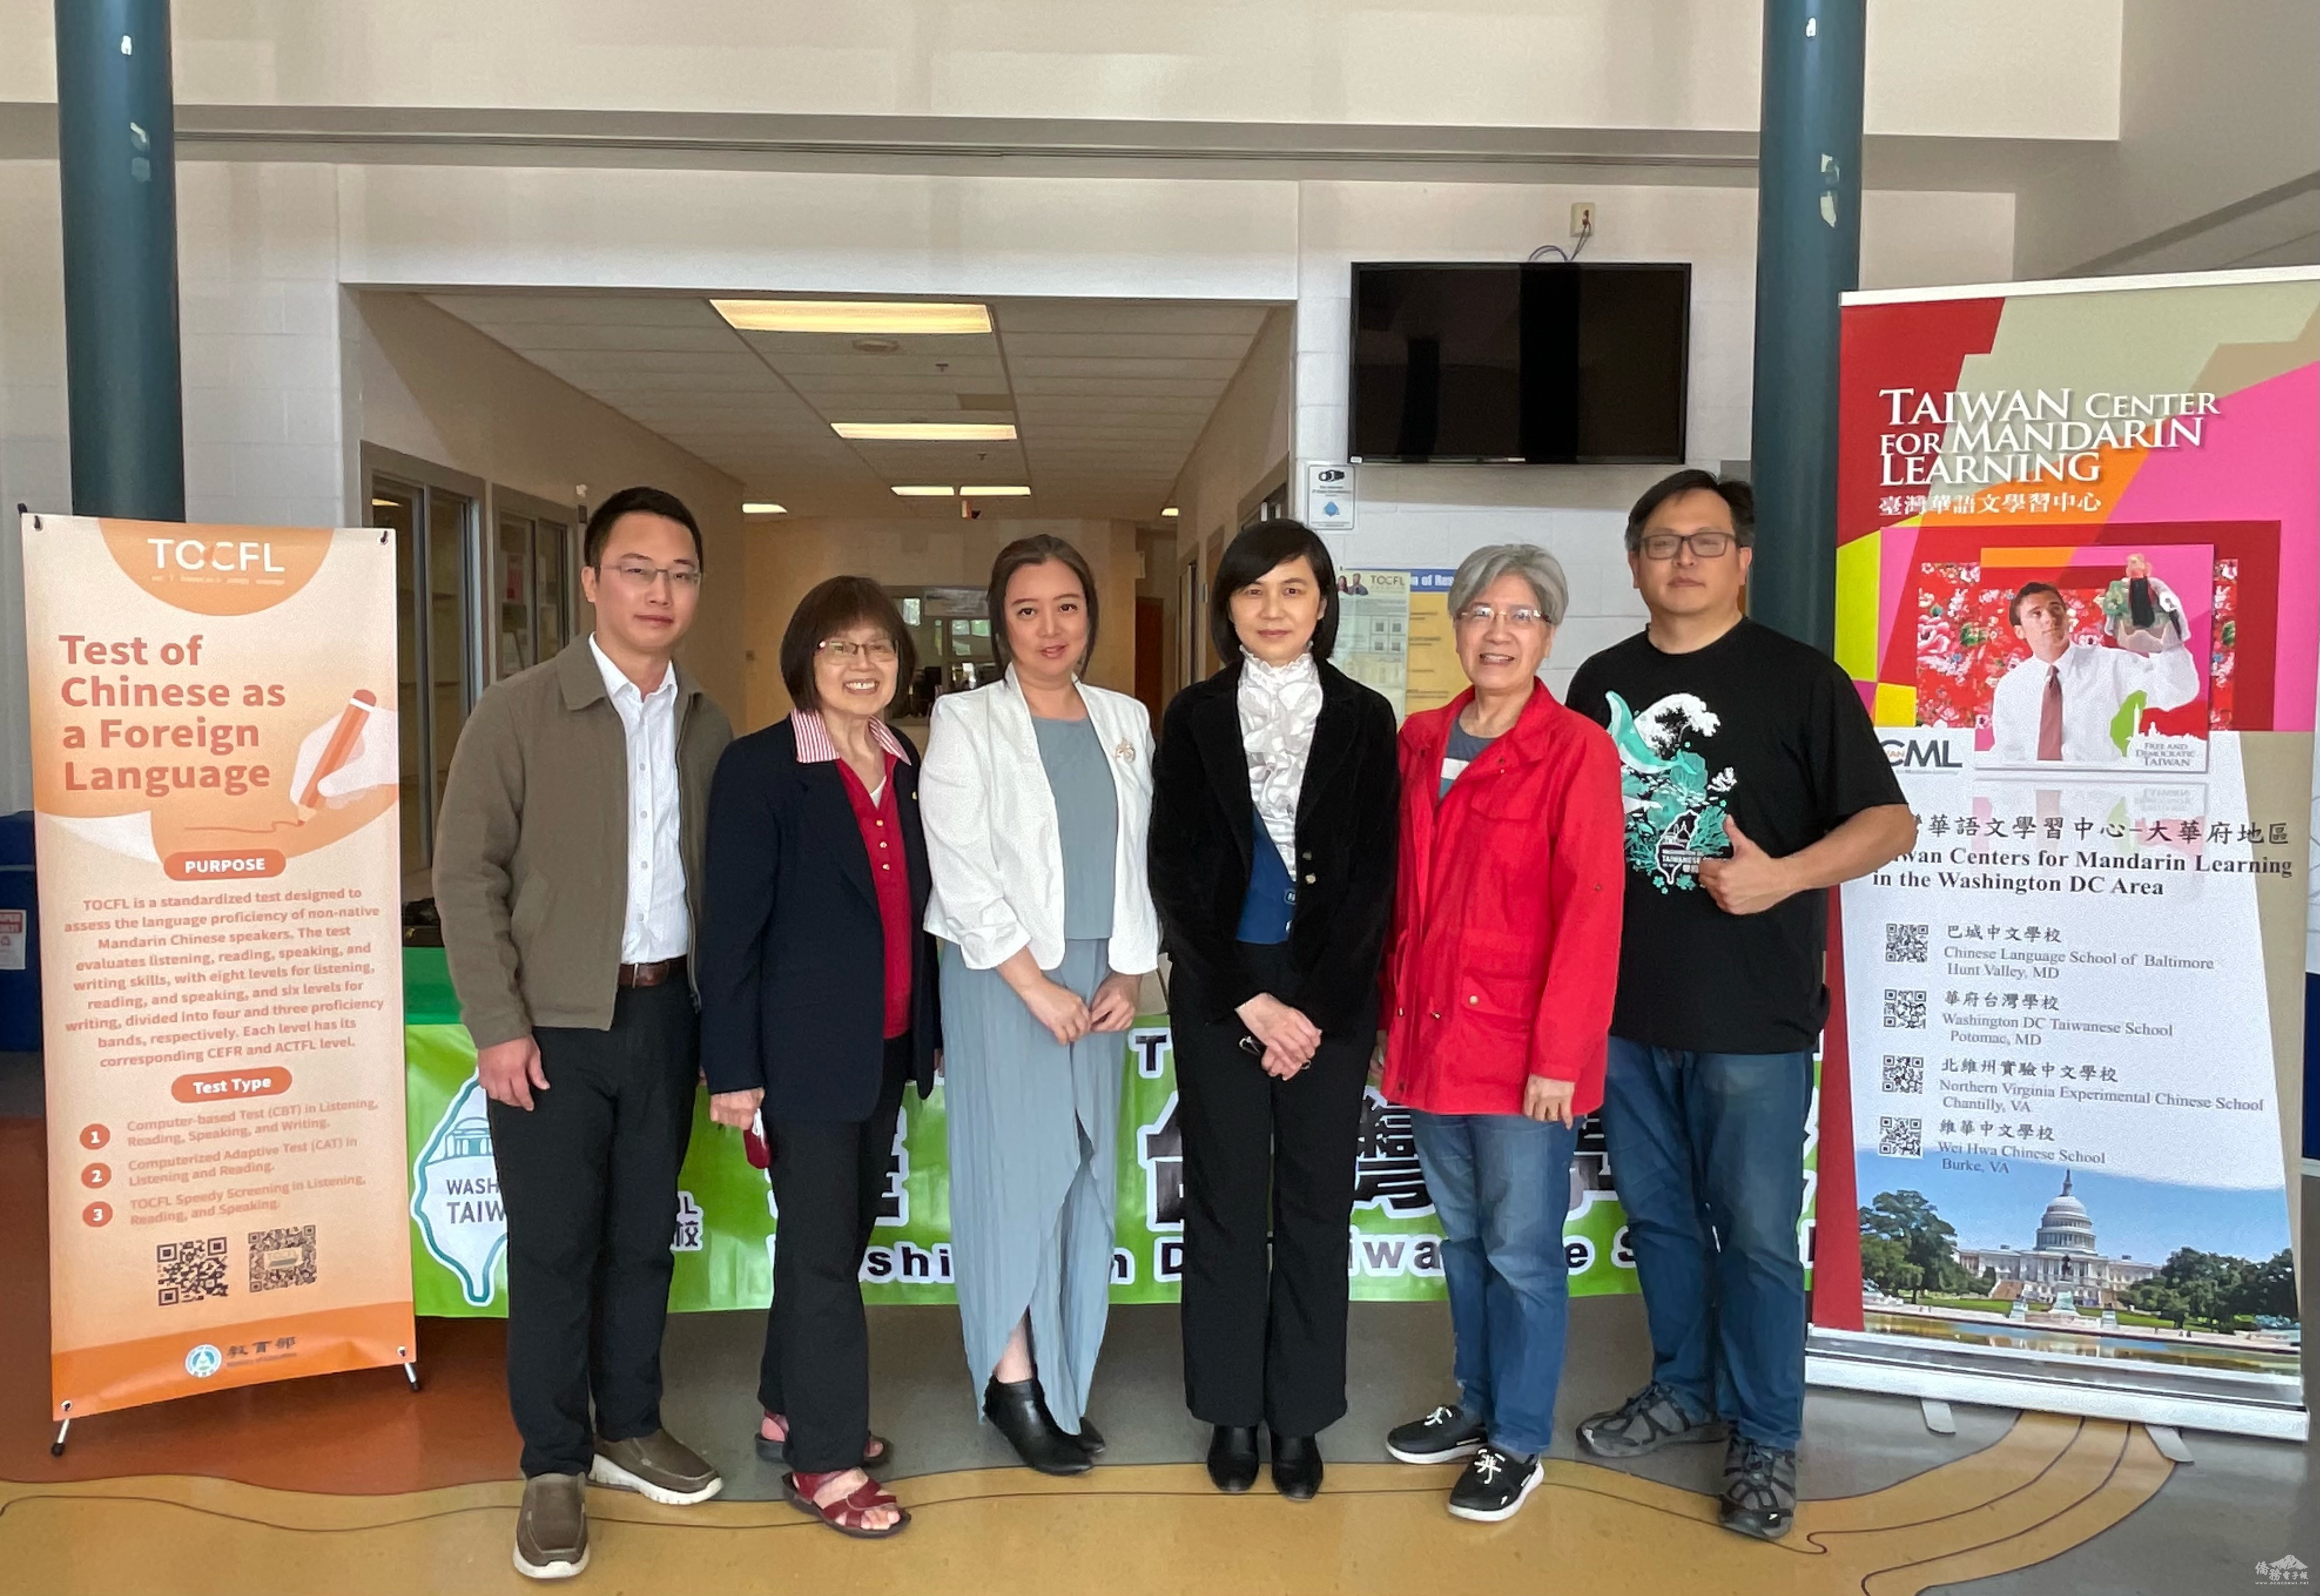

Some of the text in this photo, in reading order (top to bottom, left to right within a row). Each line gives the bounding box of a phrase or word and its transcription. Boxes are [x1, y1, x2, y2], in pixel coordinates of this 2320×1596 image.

[1880, 387, 2220, 426] TAIWAN CENTER
[1880, 419, 2203, 457] FOR MANDARIN
[1880, 452, 2100, 487] LEARNING
[147, 538, 285, 573] TOCFL
[1371, 575, 1405, 585] TOCFL
[59, 635, 203, 665] Test of
[62, 675, 285, 706] Chinese as
[63, 717, 259, 755] a Foreign
[65, 762, 270, 797] Language
[185, 858, 265, 874] PURPOSE
[1949, 848, 2292, 877] Centers for Mandarin Learning
[1873, 871, 2164, 895] in the Washington DC Area
[84, 888, 362, 910] TOCFL is a standardized test designed to
[65, 907, 379, 931] assess the language proficiency of non-native
[98, 926, 351, 948] Mandarin Chinese speakers. The test
[1947, 923, 2062, 943] 巴城中文學校
[76, 943, 371, 971] evaluates listening, reading, speaking, and
[1944, 947, 2214, 969] Chinese Language School of Baltimore
[73, 962, 375, 991] writing skills, with eight levels for listening,
[1947, 964, 2059, 981] Hunt Valley, MD
[87, 981, 364, 1009] reading, and speaking, and six levels for
[1944, 991, 2059, 1011] 華府台灣學校
[66, 998, 383, 1031] writing, divided into four and three proficiency
[1942, 1013, 2173, 1036] Washington DC Taiwanese School
[98, 1019, 356, 1048] bands, respectively. Each level has its
[1950, 1031, 2041, 1046] Potomac, MD
[100, 1038, 355, 1068] corresponding CEFR and ACTFL level.
[1942, 1059, 2119, 1083] 北維州實驗中文學校
[193, 1077, 271, 1095] Test Type
[1939, 1080, 2264, 1111] Northern Virginia Experimental Chinese School
[127, 1099, 378, 1131] Computer-based Test (CBT) in Listening,
[1942, 1097, 2031, 1113] Chantilly, VA
[91, 1132, 100, 1143] 1
[127, 1119, 329, 1147] Reading, Speaking, and Writing.
[1939, 1119, 2055, 1140] 維華中文學校
[128, 1137, 357, 1171] Computerized Adaptive Test (CAT) in
[1938, 1142, 2106, 1163] Wei Hwa Chinese School
[92, 1171, 100, 1181] 2
[129, 1161, 274, 1187] Listening and Reading.
[1942, 1158, 2009, 1174] Burke, VA
[131, 1174, 365, 1210] TOCFL Speedy Screening in Listening,
[93, 1209, 102, 1220] 3
[130, 1199, 280, 1226] Reading, and Speaking.
